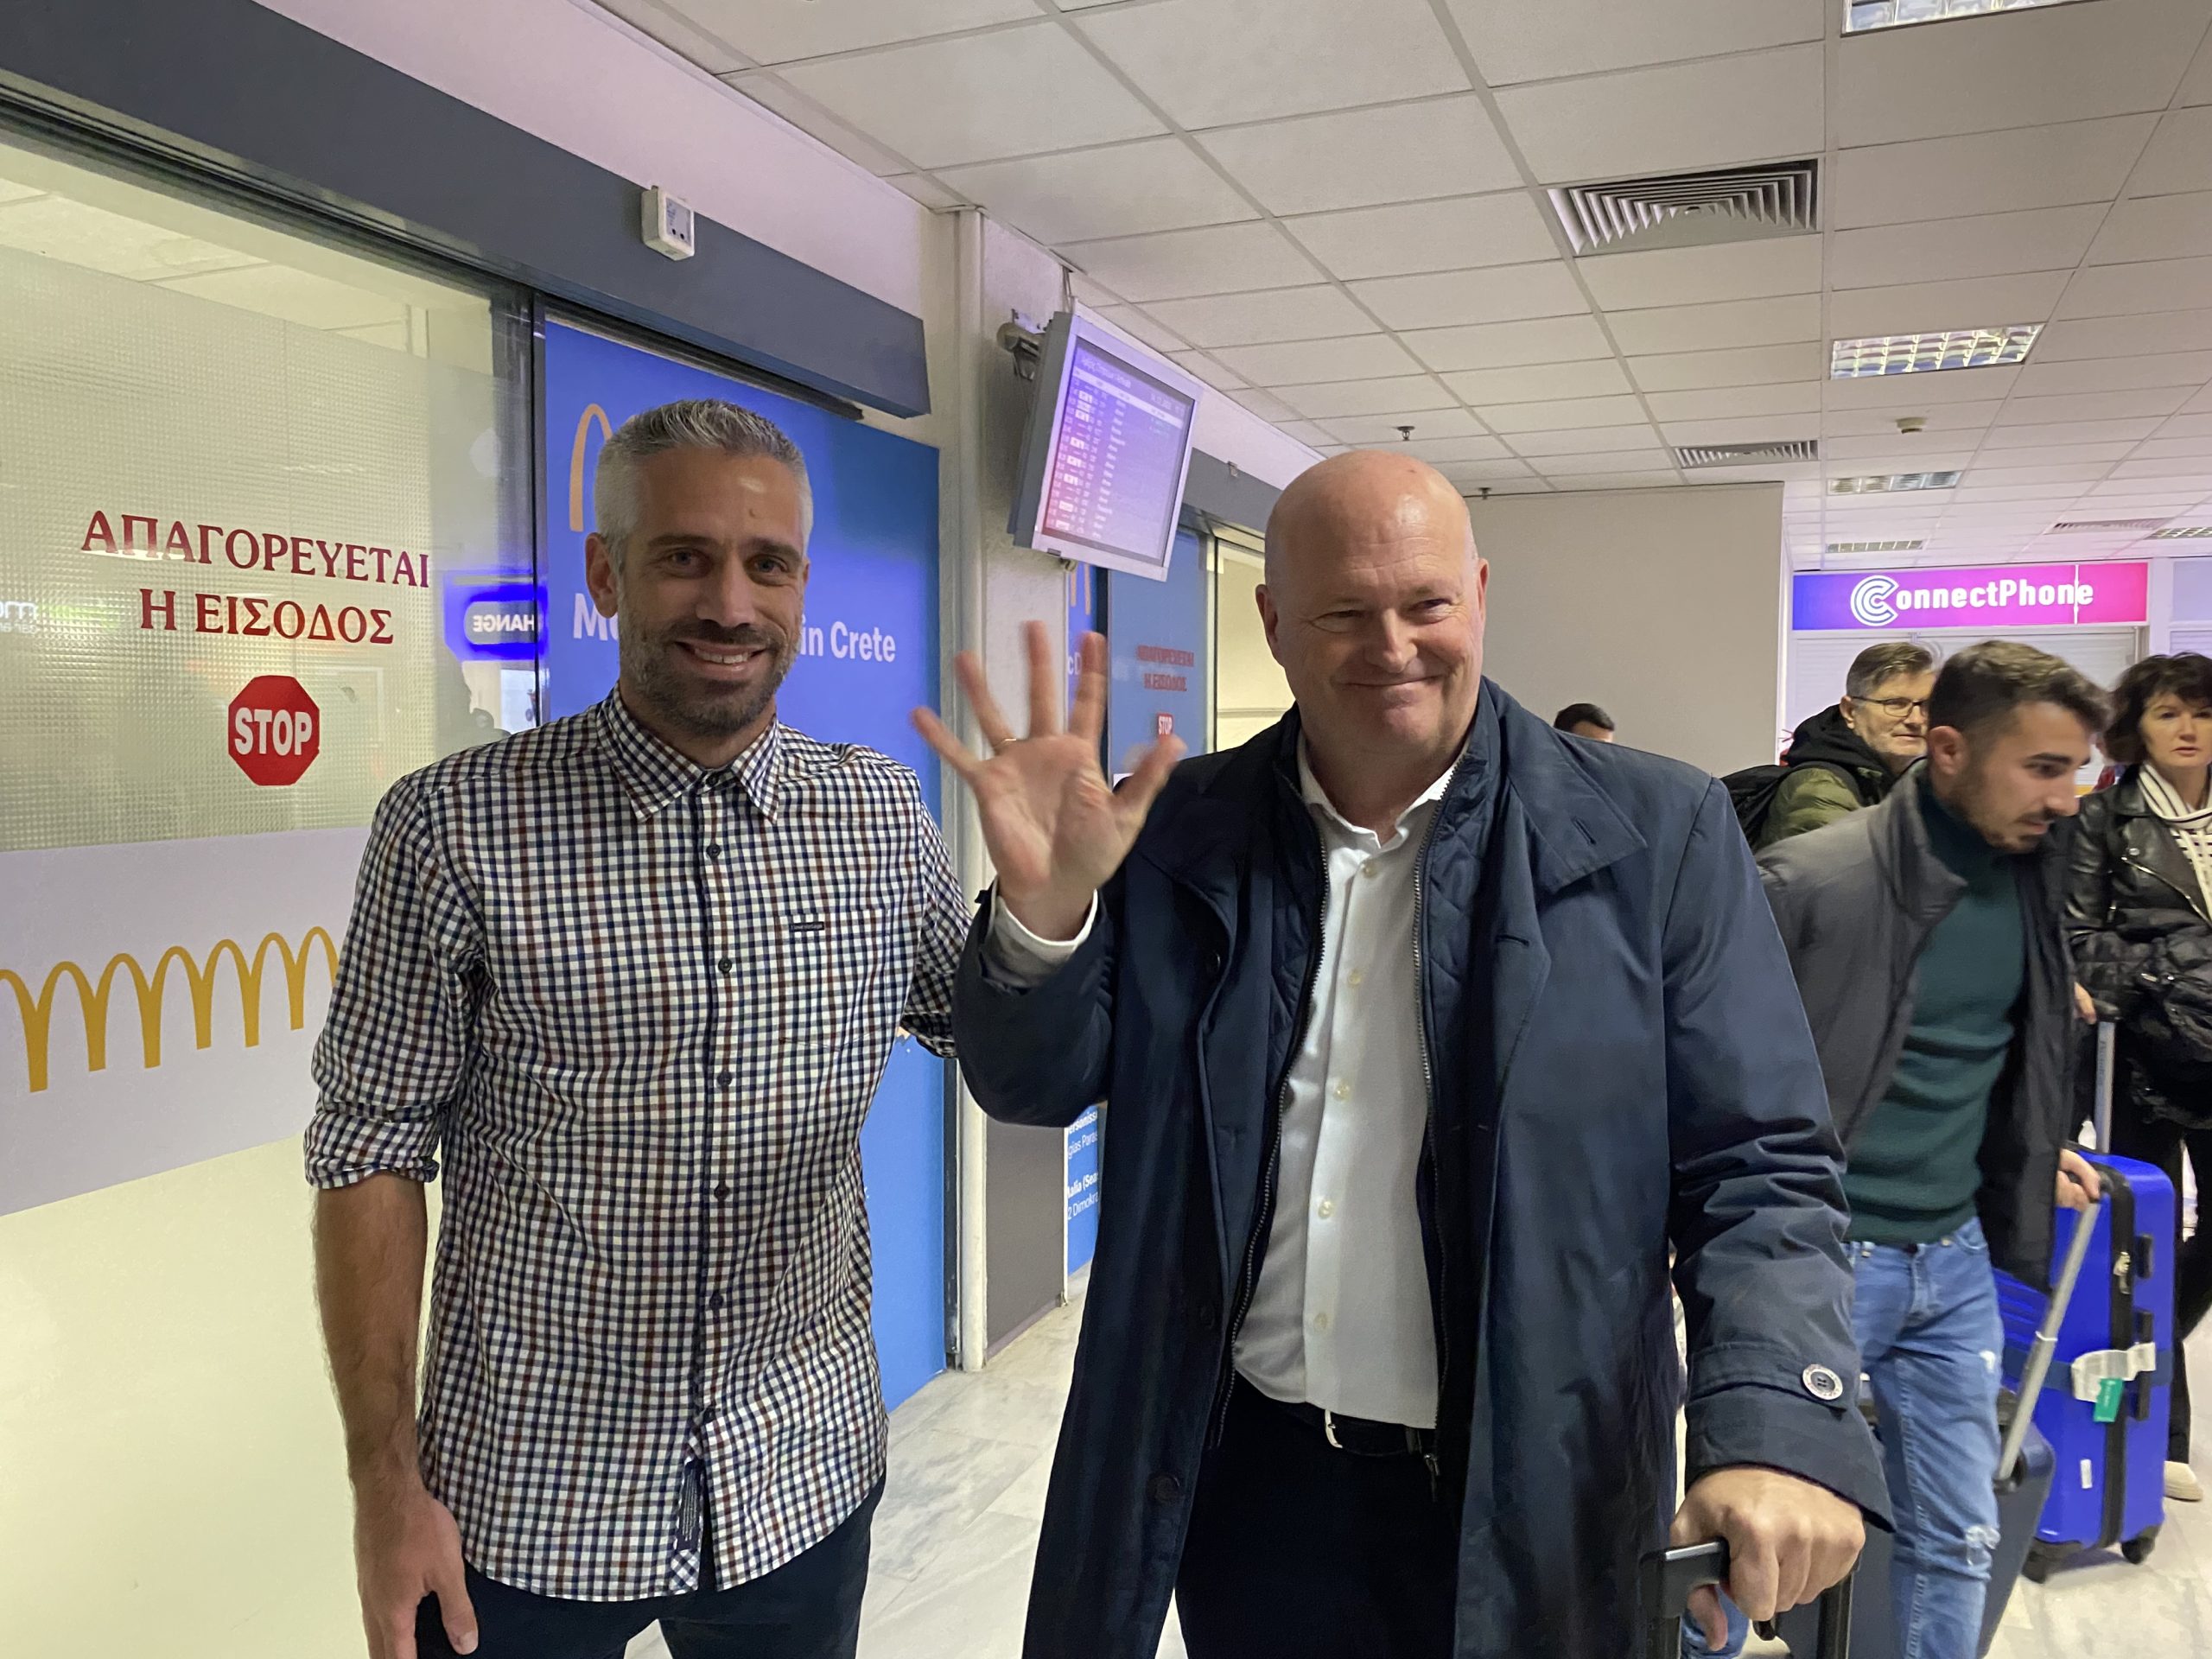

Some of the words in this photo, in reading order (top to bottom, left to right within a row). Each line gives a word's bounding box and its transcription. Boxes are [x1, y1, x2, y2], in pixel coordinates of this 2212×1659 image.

[81, 511, 430, 588] ΑΠΑΓΟΡΕΥΕΤΑΙ
[140, 588, 177, 631] Η
[195, 593, 394, 644] ΕΙΣΟΔΟΣ
[830, 620, 896, 663] Crete
[234, 709, 313, 757] STOP
